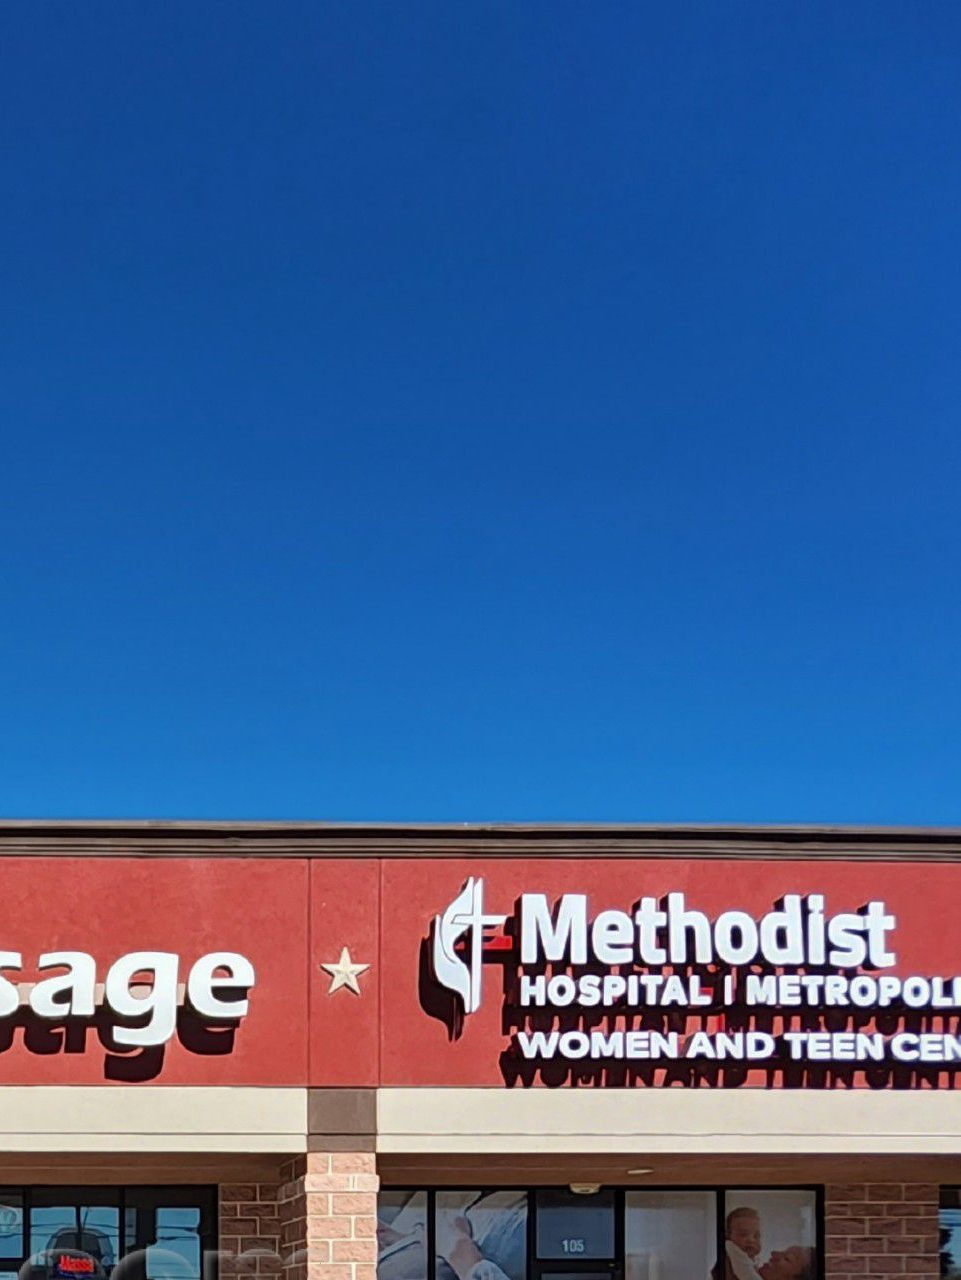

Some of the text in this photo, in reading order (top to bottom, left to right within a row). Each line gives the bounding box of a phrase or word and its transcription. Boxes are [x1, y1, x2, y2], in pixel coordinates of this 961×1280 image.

[521, 892, 895, 967] Methodist
[520, 975, 713, 1008] HOSPITAL
[517, 1031, 678, 1061] WOMEN
[686, 1031, 775, 1061] AND
[784, 1032, 883, 1062] TEEN
[562, 1239, 585, 1252] 105
